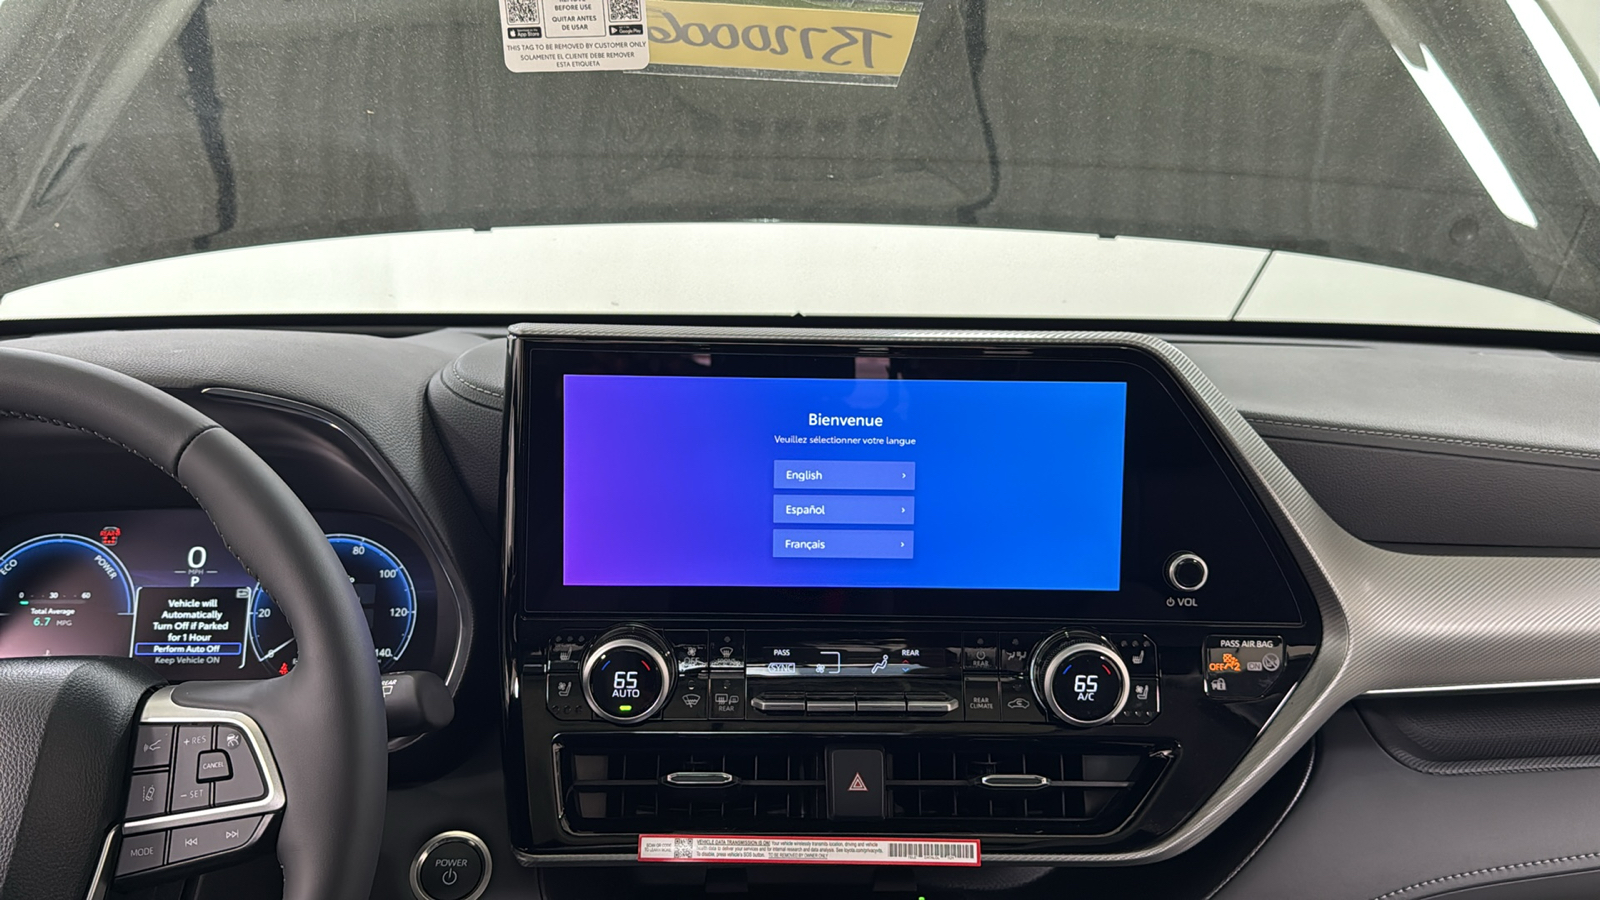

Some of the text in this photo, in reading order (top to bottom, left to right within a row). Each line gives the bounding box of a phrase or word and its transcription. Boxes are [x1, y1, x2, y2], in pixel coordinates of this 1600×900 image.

[808, 413, 883, 427] Bienvenue
[774, 435, 916, 447] Veuillez sélectionner votre langue
[786, 470, 823, 481] English
[786, 505, 825, 516] Español
[785, 539, 826, 550] Français
[352, 546, 365, 555] 80
[187, 546, 207, 569] 0
[0, 559, 18, 575] ECO
[94, 554, 118, 580] POWER
[379, 570, 396, 578] 100
[190, 576, 200, 587] P
[168, 599, 218, 607] Vehicle will
[1177, 598, 1198, 606] VOL
[48, 608, 75, 616] Average
[161, 610, 223, 621] Automatically
[258, 608, 271, 618] 20
[390, 608, 408, 617] 120
[33, 617, 51, 626] 6.7
[153, 622, 229, 630] Turn Off if Parked
[168, 633, 212, 641] for 1 Hour
[1257, 640, 1273, 648] BAG
[375, 648, 391, 657] 140
[155, 657, 175, 665] Keep
[613, 672, 638, 689] 65
[1074, 675, 1098, 692] 65
[612, 690, 640, 698] AUTO
[1077, 693, 1094, 701] A/C
[192, 736, 206, 744] RES
[203, 761, 224, 769] CANCEL
[190, 789, 204, 798] SET
[130, 847, 154, 857] MODE
[435, 859, 468, 867] POWER
